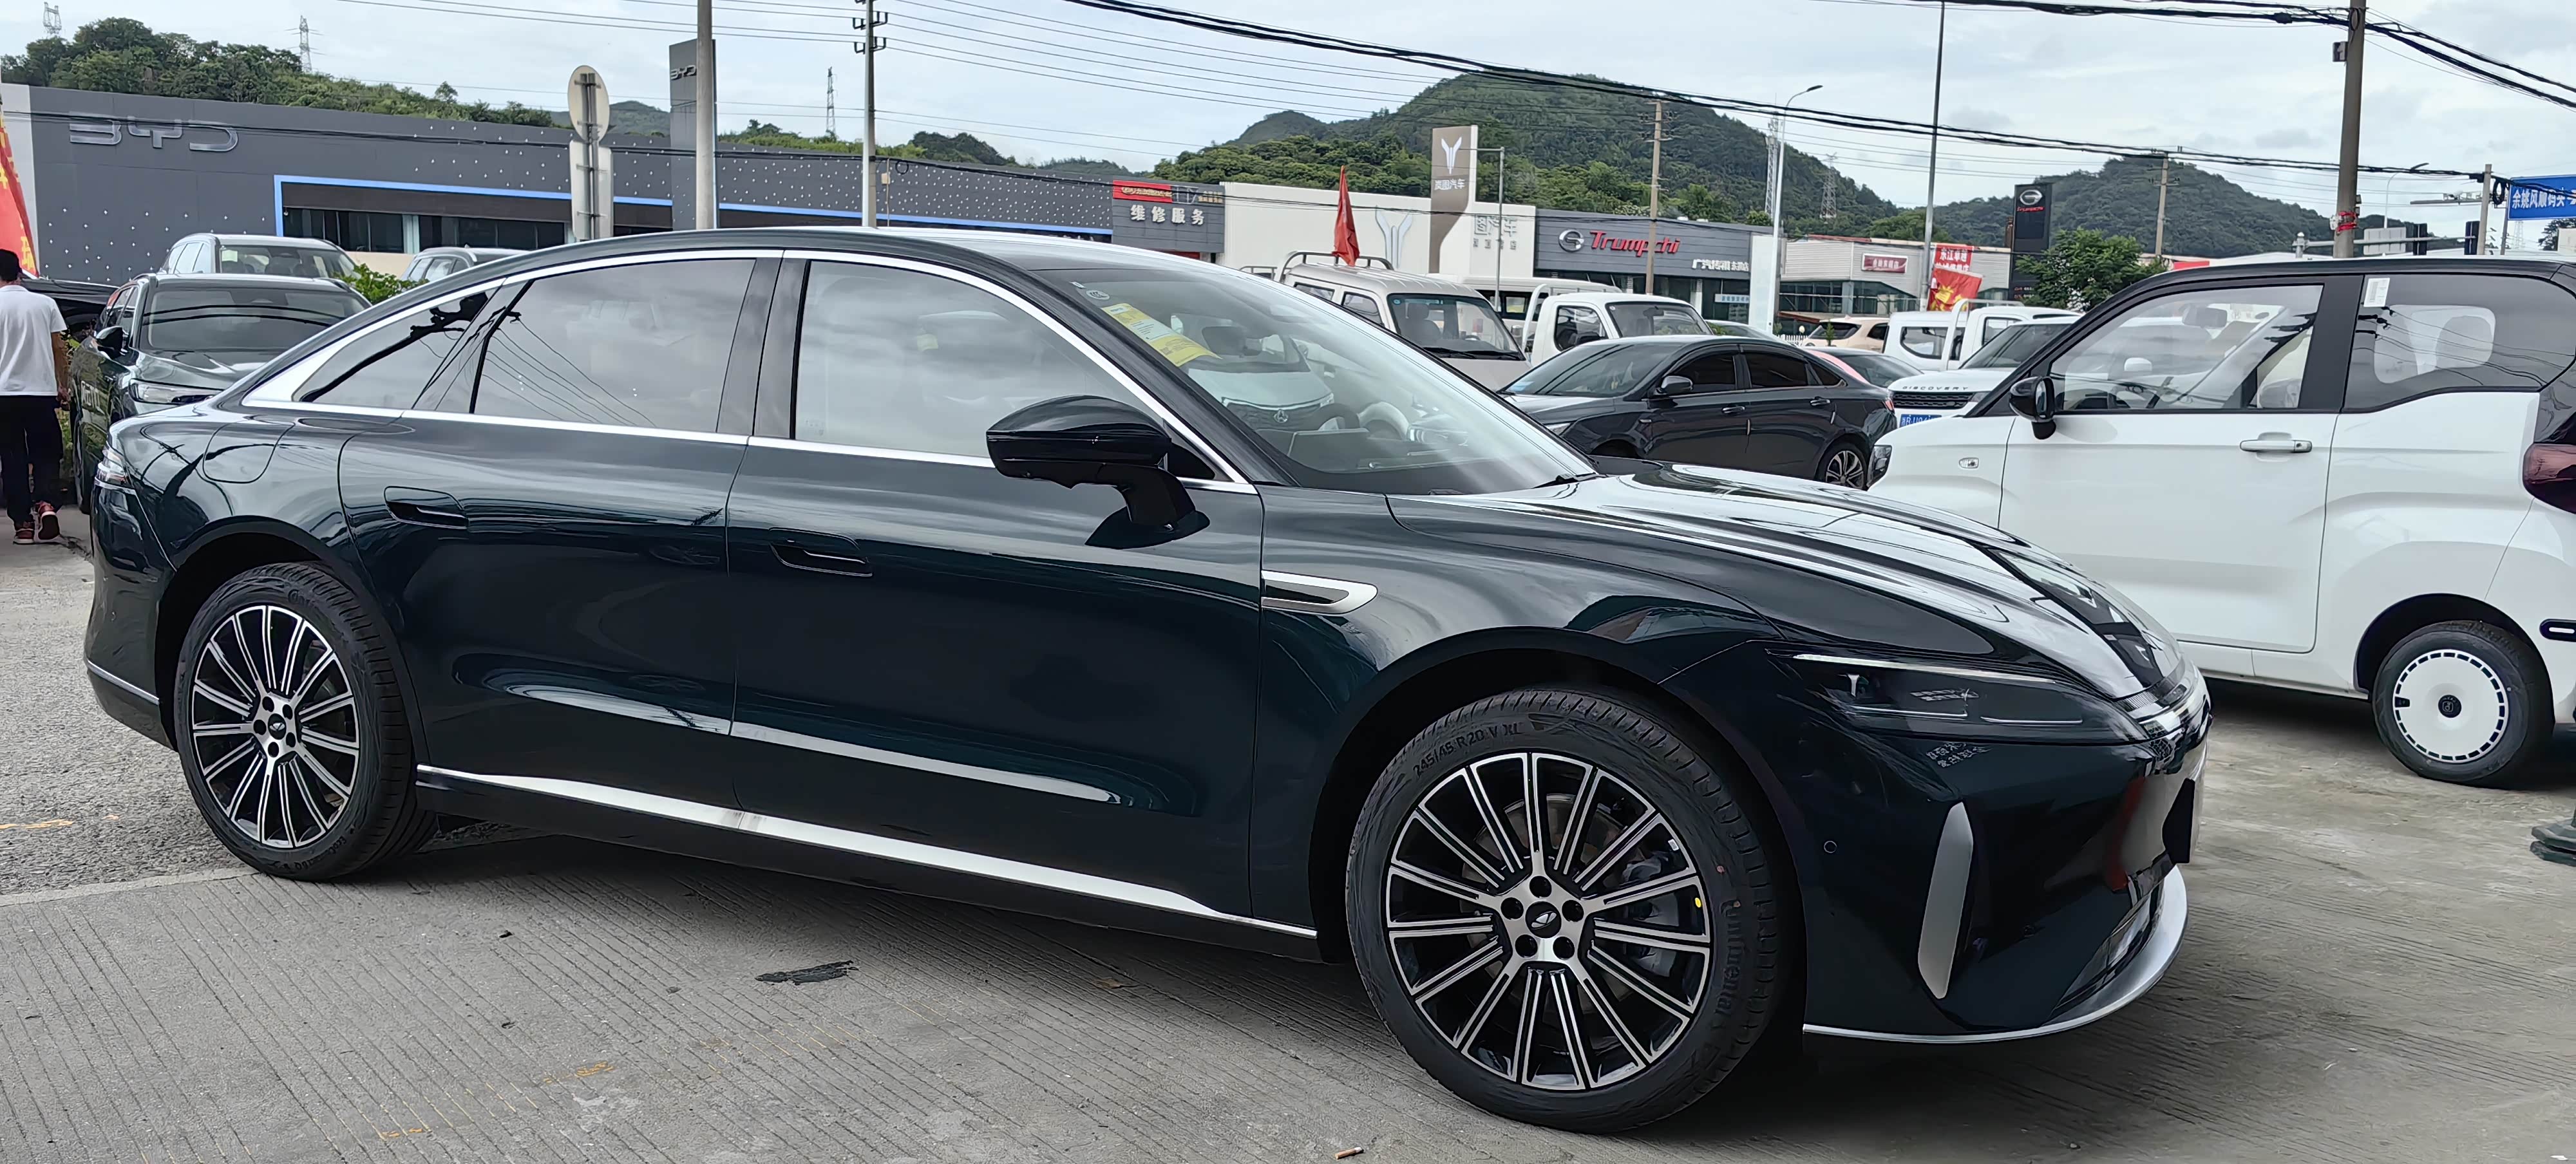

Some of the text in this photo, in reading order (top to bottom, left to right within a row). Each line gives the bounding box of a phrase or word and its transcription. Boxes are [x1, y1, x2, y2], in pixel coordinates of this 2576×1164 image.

[69, 111, 239, 152] BYD
[1130, 204, 1204, 225] 维修服务
